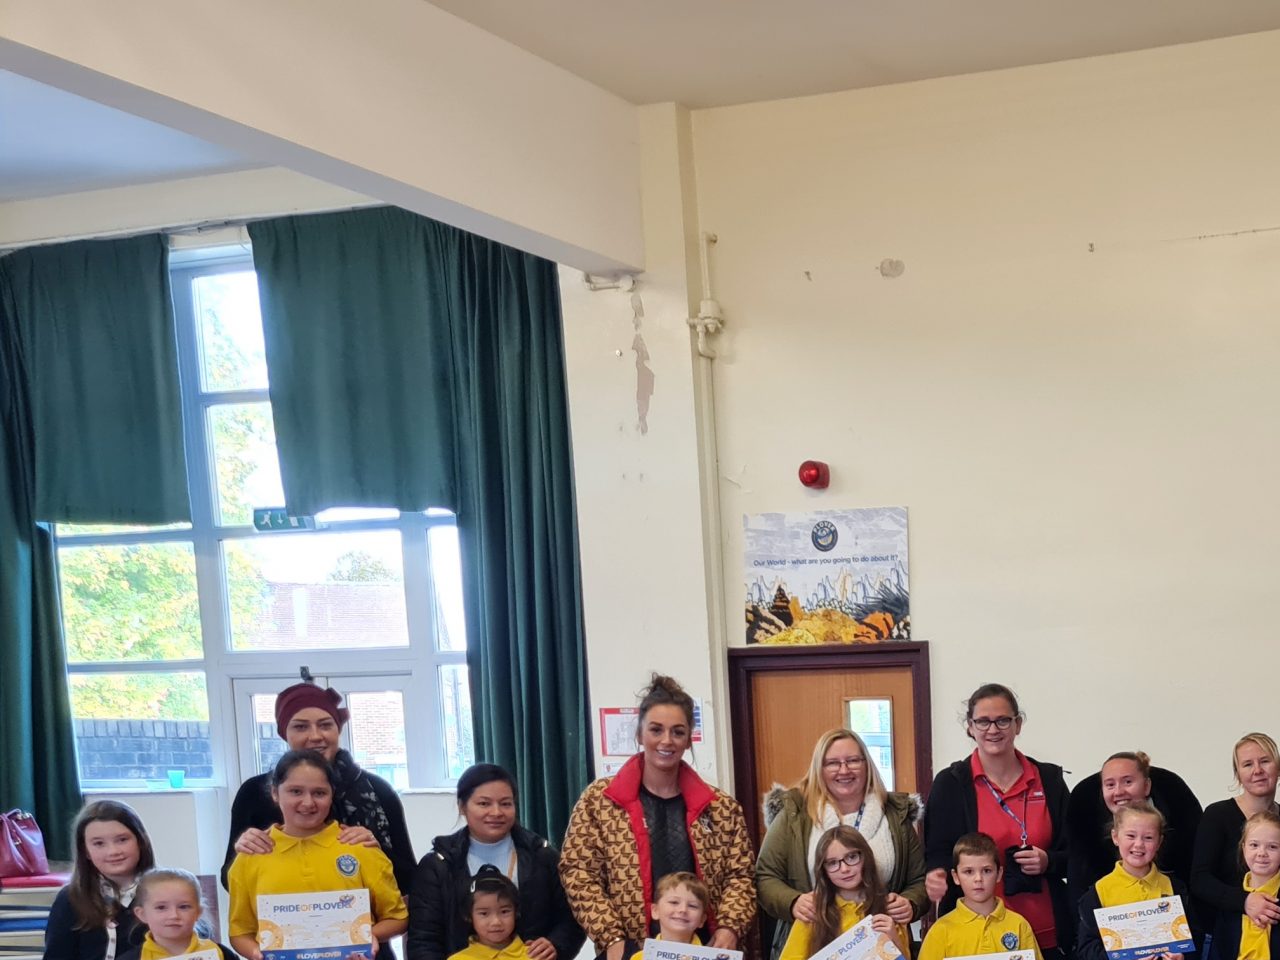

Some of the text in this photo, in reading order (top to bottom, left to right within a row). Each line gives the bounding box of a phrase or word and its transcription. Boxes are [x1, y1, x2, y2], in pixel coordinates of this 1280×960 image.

[753, 559, 764, 567] Our
[819, 558, 831, 566] you
[833, 557, 851, 565] going
[870, 554, 889, 562] about
